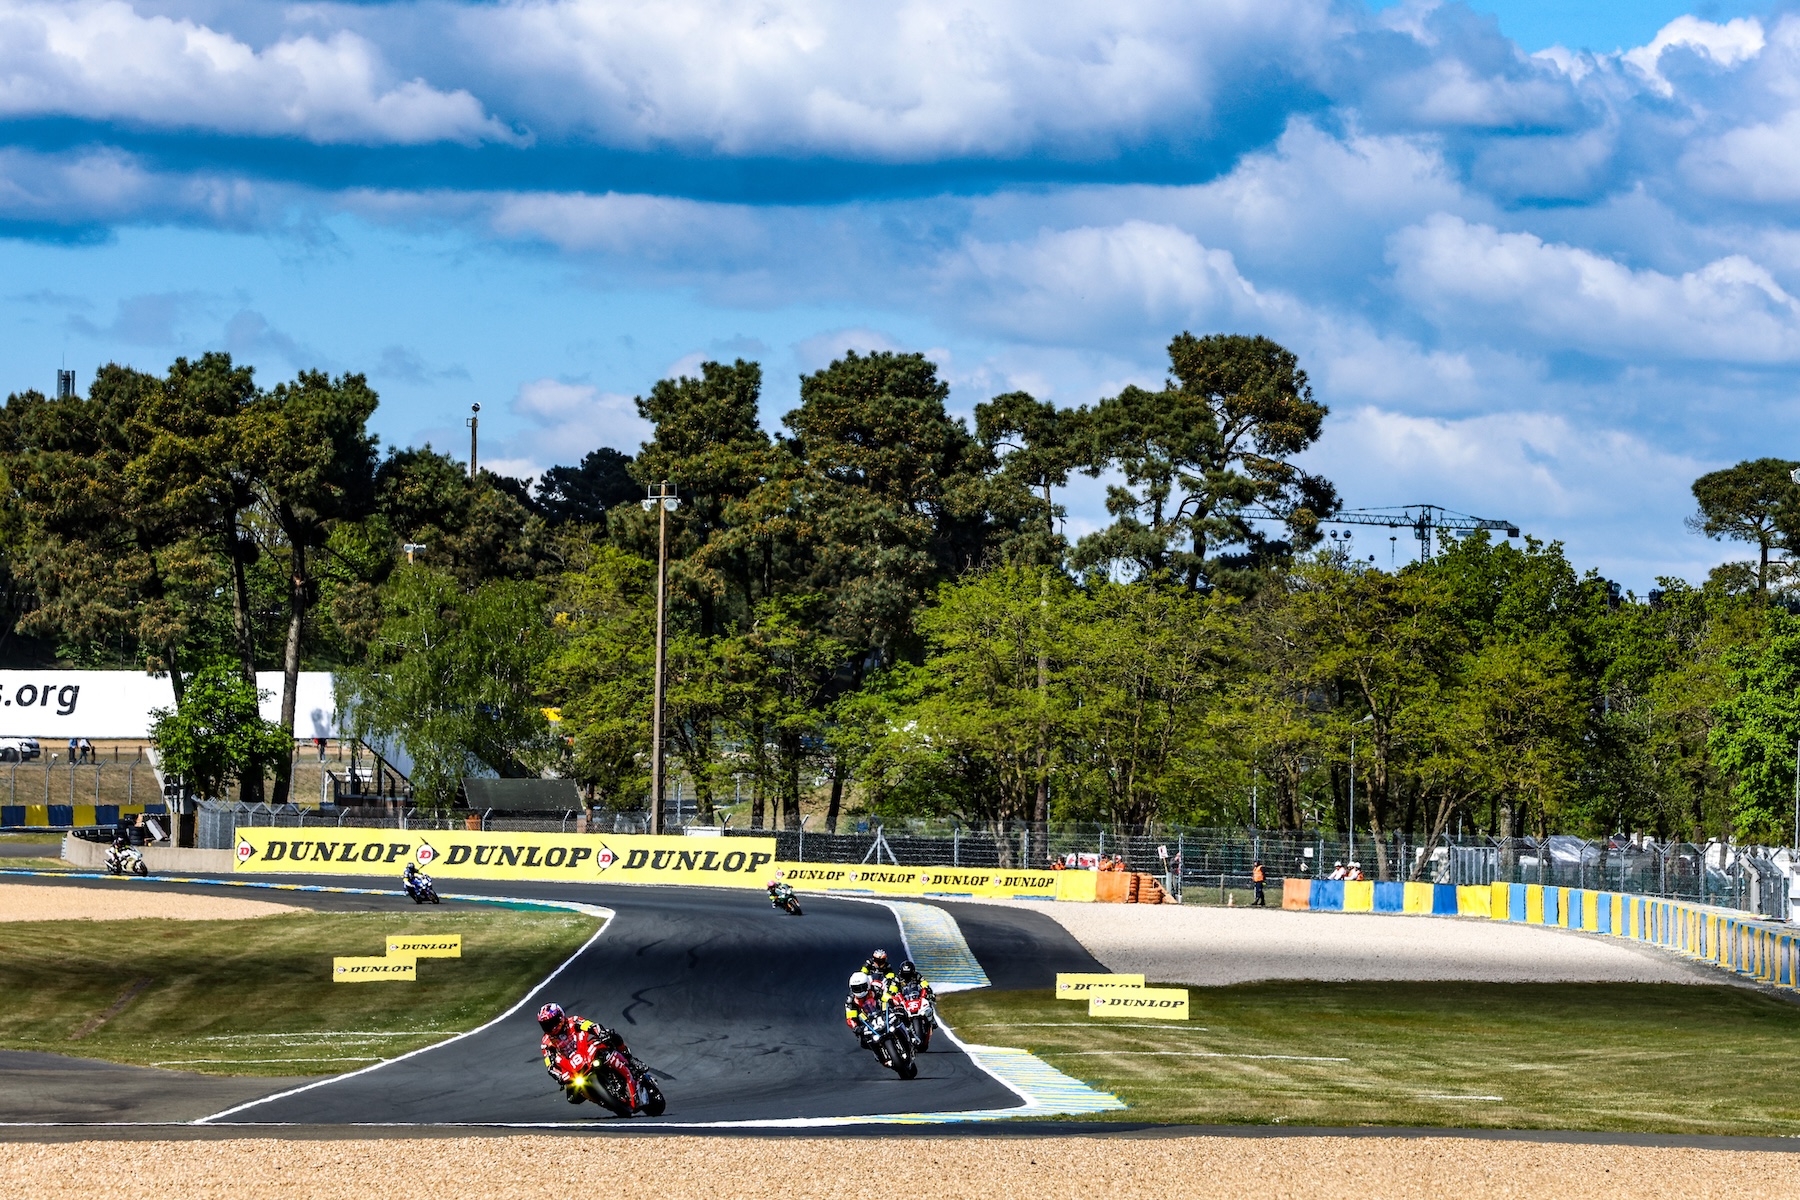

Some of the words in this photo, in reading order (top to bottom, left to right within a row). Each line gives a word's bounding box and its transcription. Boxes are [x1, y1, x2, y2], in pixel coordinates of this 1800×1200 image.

[0, 684, 80, 716] .org
[260, 841, 411, 863] DUNLOP
[443, 845, 592, 868] DUNLOP
[622, 849, 772, 873] DUNLOP
[786, 870, 845, 881] DUNLOP
[860, 872, 916, 883] DUNLOP
[931, 875, 990, 886] DUNLOP
[1003, 877, 1055, 888] DUNLOP
[350, 965, 414, 973] DUNLOP
[1108, 998, 1185, 1008] DUNLOP
[569, 1053, 584, 1069] 18
